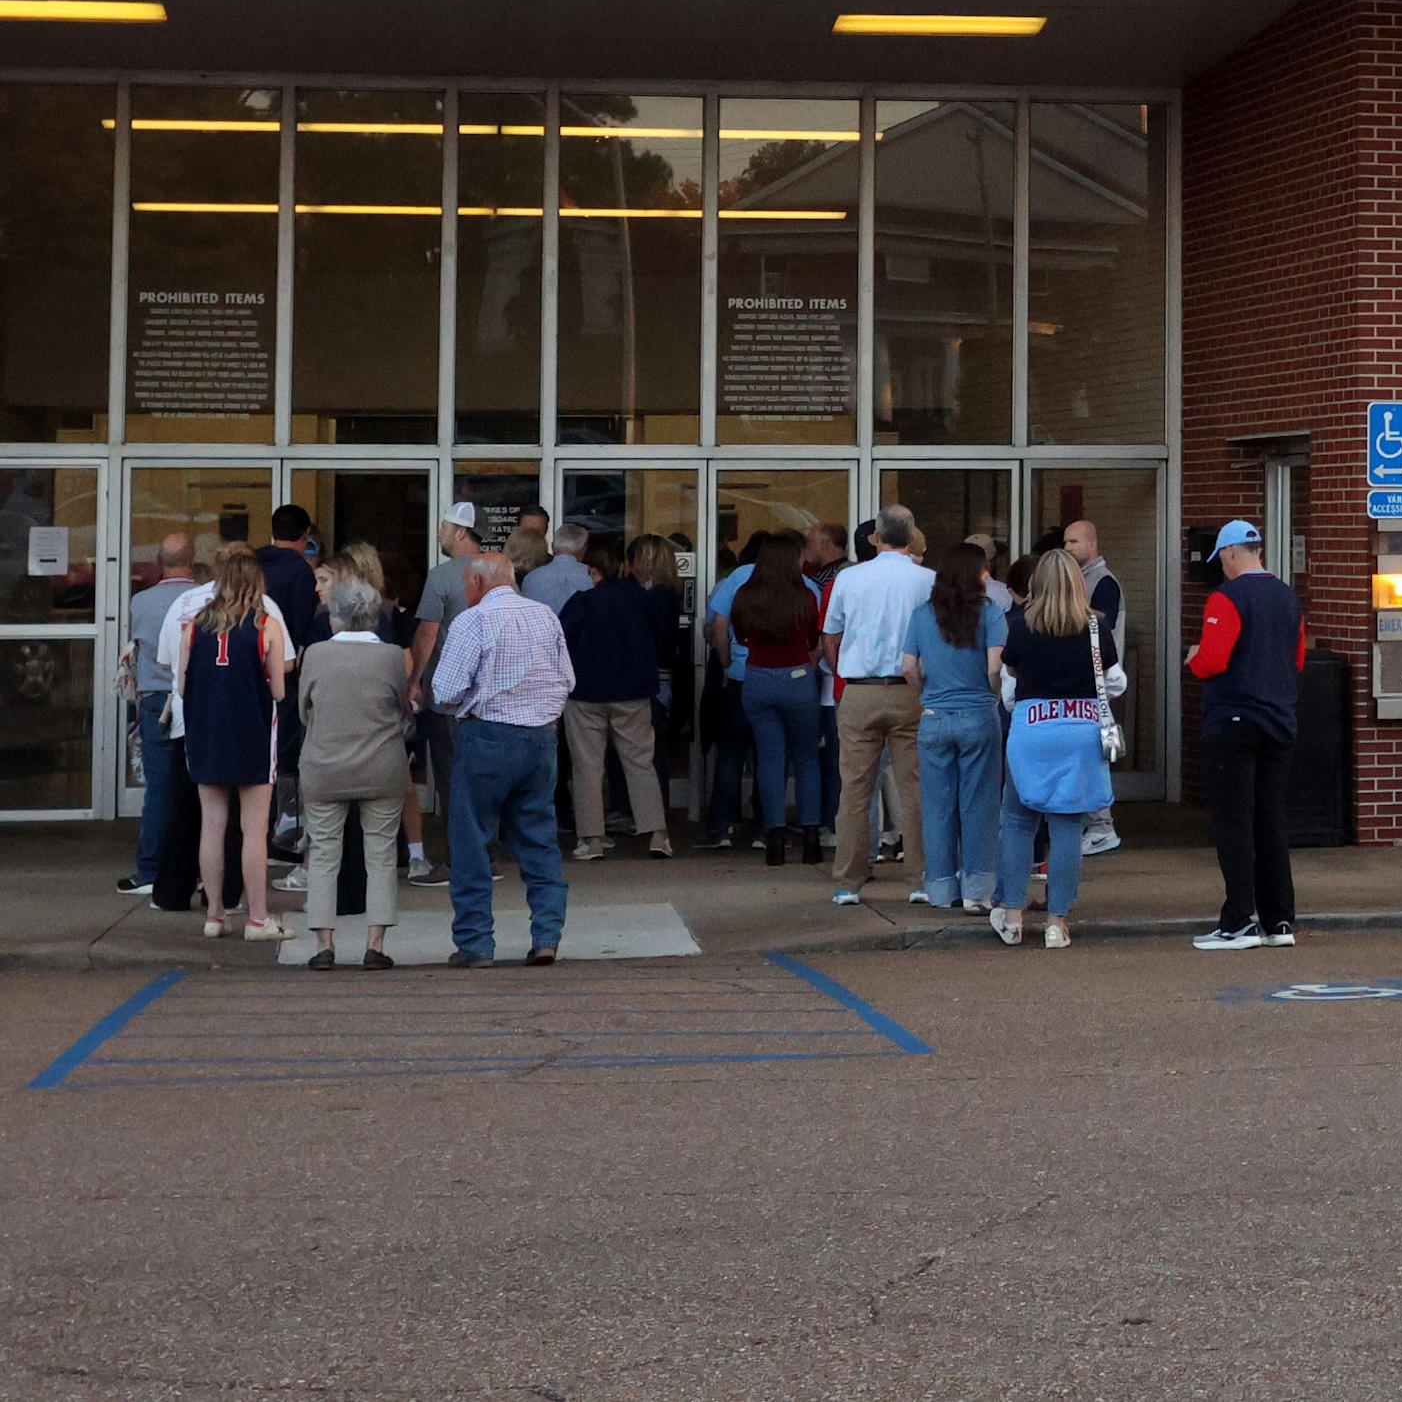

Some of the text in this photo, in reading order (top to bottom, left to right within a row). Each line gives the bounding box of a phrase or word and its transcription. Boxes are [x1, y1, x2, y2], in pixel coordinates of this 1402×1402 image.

[139, 292, 265, 305] PROHIBITED ITEMS
[728, 298, 847, 309] PROHIBITED ITEMS
[1387, 495, 1402, 503] VAN
[216, 631, 229, 666] 1
[1092, 645, 1104, 678] TODDY
[1027, 699, 1099, 725] OLE MISS
